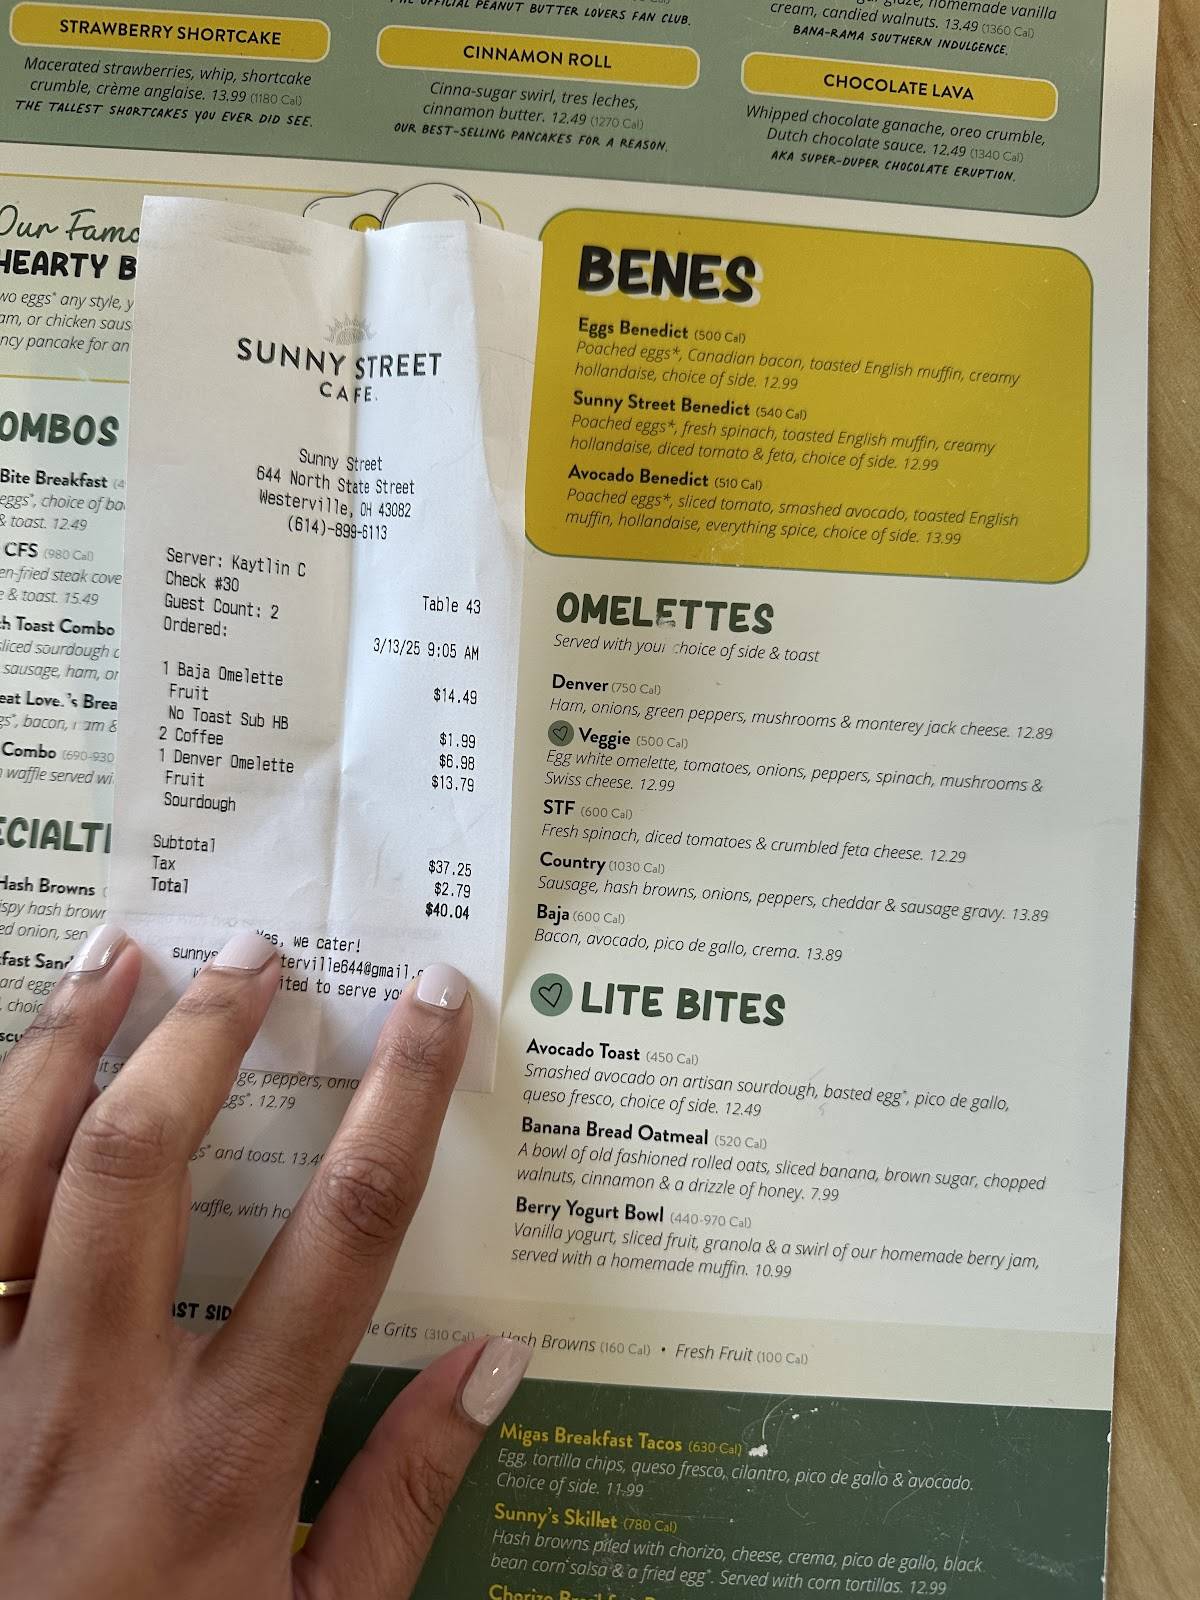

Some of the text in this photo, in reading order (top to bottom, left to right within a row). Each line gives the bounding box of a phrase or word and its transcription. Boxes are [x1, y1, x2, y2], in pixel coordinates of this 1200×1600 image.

[59, 19, 281, 46] STRAWBERRY SHORTCAKE
[793, 24, 1008, 56] BANA-RAMA SOUTHERN INDULGENCE.
[463, 45, 612, 69] CINNAMON ROLL
[24, 56, 312, 86] Macerated strawberries, whip, shortcake
[823, 73, 974, 101] CHOCOLATE LAVA
[15, 100, 43, 112] THE
[48, 102, 104, 114] TALLEST
[109, 105, 189, 119] SHORTCAKES
[221, 111, 253, 123] EVER
[258, 114, 281, 124] DID
[286, 115, 313, 127] SEE.
[771, 150, 1015, 182] AKA SUPER-DUPER CHOCOLATE ERUPTION.
[0, 204, 59, 239] Our
[576, 244, 760, 305] BENES
[45, 313, 97, 330] chicken
[578, 316, 746, 345] Eggs Benedict (500 Cal)
[25, 335, 108, 354] pancake for
[237, 336, 443, 381] SUNNY STREET
[573, 389, 807, 421] Sunny Street Benedict (540 Cal)
[0, 410, 120, 447] OMBOS
[299, 448, 383, 472] Sunny Street
[0, 468, 108, 489] Bite Breakfast
[256, 465, 415, 495] 644 North State Street
[567, 463, 763, 491] Avocado Benedict (510 Cal)
[259, 488, 412, 520] Westerville, OH 43082
[288, 515, 388, 540] (614)-899-6113
[3, 542, 39, 558] CFS
[166, 547, 306, 577] Server: Kaytlin C
[165, 570, 240, 592] Check #30
[164, 592, 279, 620] Guest Count: 2
[422, 595, 481, 615] Table 43
[556, 591, 774, 635] OMELETTES
[15, 615, 115, 636] Toast Combo
[163, 615, 227, 637] Ordered:
[373, 637, 479, 661] 3/13/25 9:05 AM
[163, 660, 283, 687] 1 Baja Omelette
[552, 673, 661, 696] Denver (750 Cal)
[169, 683, 209, 701] Fruit
[433, 687, 477, 705] $14.49
[168, 705, 289, 730] No Toast Sub HB
[159, 725, 224, 746] 2 Coffee
[439, 731, 476, 749] $1.99
[578, 726, 689, 751] Veggie (500 Cal)
[159, 748, 294, 773] 1 Denver Omelette
[439, 753, 475, 771] $6.98
[165, 769, 205, 787] Fruit
[431, 775, 474, 793] $13.79
[164, 791, 236, 813] Sourdough
[153, 834, 215, 853] Subtotal
[152, 855, 176, 871] Tax
[428, 859, 472, 877] $37.25
[539, 851, 665, 876] Country (1030 Cal)
[151, 876, 189, 894] Total
[434, 881, 471, 899] $2.79
[425, 901, 470, 920] $40.04
[293, 936, 361, 953] we cater!
[581, 981, 786, 1027] LITE BITES
[526, 1037, 699, 1066] Avocado Toast (450 Cal)
[521, 1116, 767, 1150] Banana Bread Oatmeal (520 Cal)
[515, 1195, 752, 1229] Berry Yogurt Bowl (440-970 Cal)
[511, 1248, 792, 1279] served with a homemade muffin. 10.99
[675, 1343, 809, 1365] Fresh Fruit (100 Cal)
[499, 1422, 743, 1458] Migas Breakfast Tacos (630 Cal)
[494, 1502, 678, 1535] Sunny's Skillet (780 Cal)
